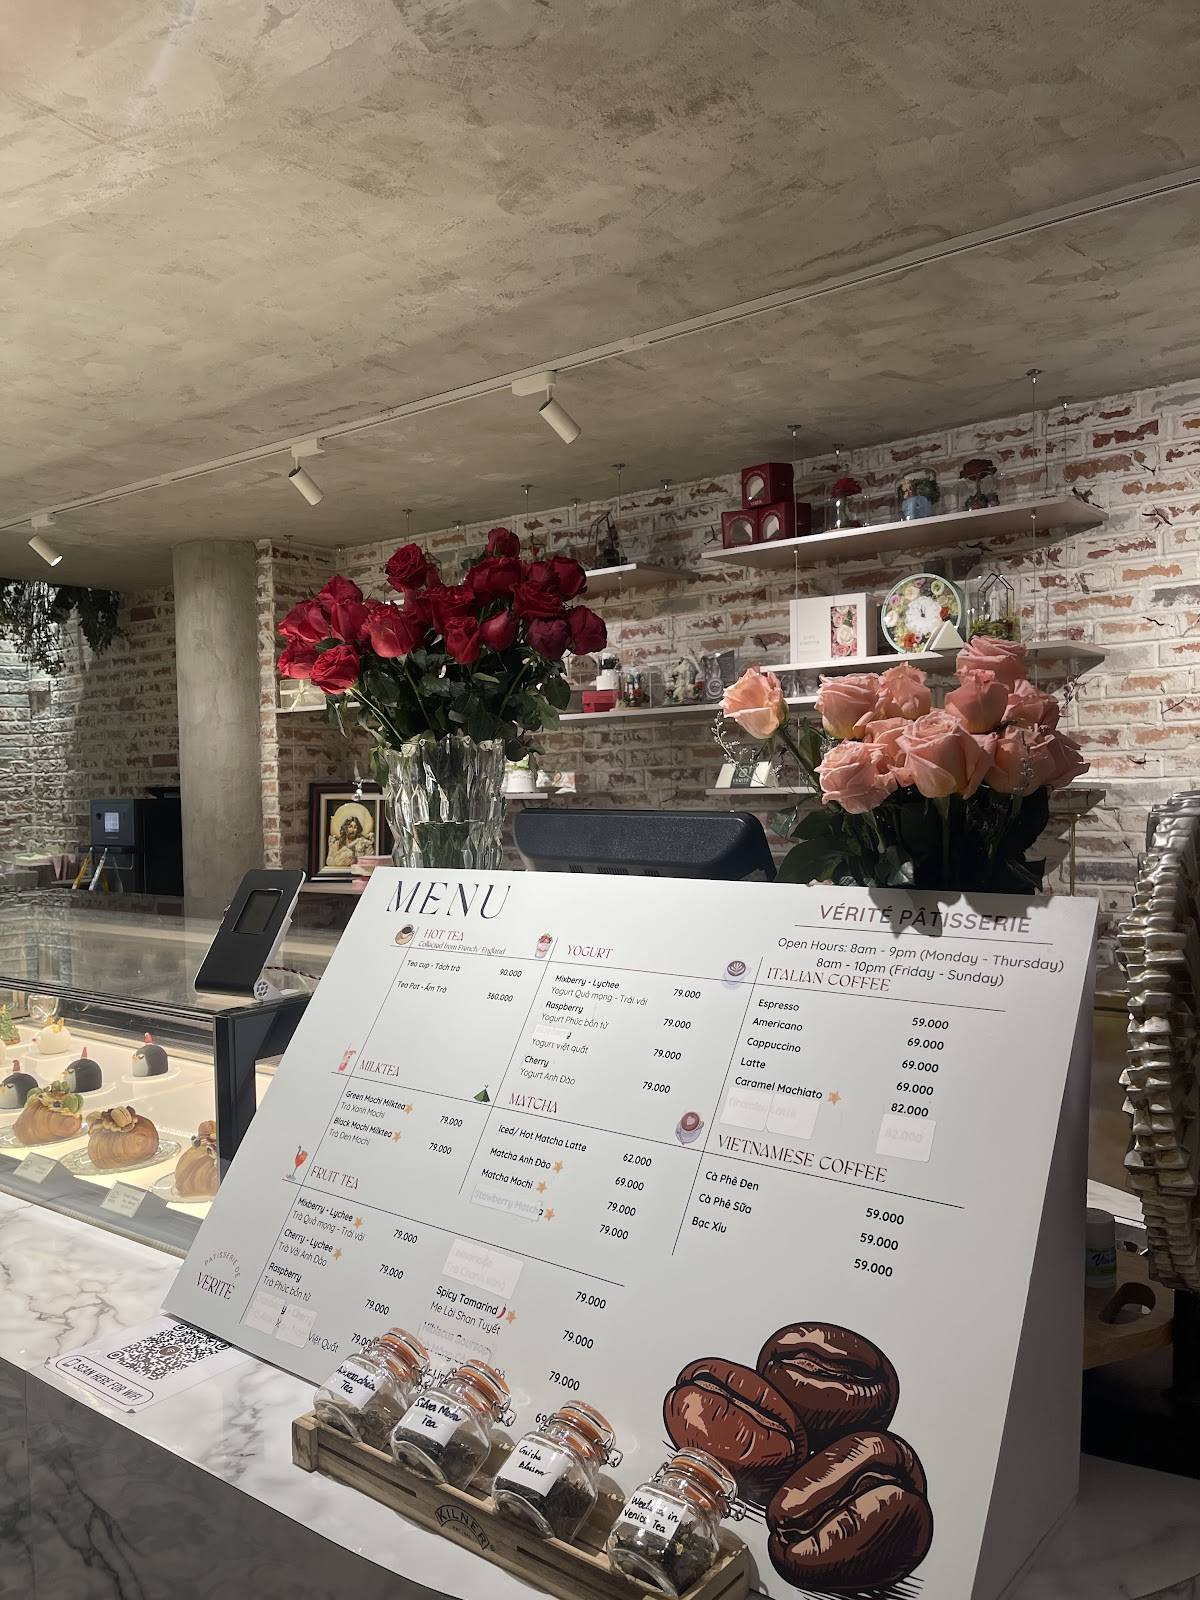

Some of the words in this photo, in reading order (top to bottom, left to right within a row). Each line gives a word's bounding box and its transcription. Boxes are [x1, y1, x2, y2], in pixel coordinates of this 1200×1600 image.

[386, 880, 512, 919] MENU
[820, 904, 893, 924] VÉRITÉ
[898, 907, 1032, 933] PÂTISSERIE
[424, 929, 445, 939] HOT
[447, 931, 464, 941] TEA
[567, 944, 613, 960] YOGURT
[778, 937, 808, 950] Open
[810, 940, 848, 953] Hours:
[850, 944, 877, 955] 8am
[889, 946, 916, 959] 9pm
[919, 949, 978, 966] (Monday
[992, 954, 1065, 973] Thursday)
[407, 960, 418, 968] Tea
[499, 969, 522, 978] 90.000
[767, 967, 824, 985] ITALIAN
[827, 973, 891, 992] COFFEE
[816, 958, 842, 969] 8am
[853, 961, 886, 975] 10pm
[889, 964, 935, 981] (Friday
[947, 969, 1004, 987] Sunday)
[397, 981, 409, 989] Tea
[409, 982, 419, 990] Pot
[555, 975, 587, 986] Mixberry
[592, 979, 620, 989] Lychee
[487, 992, 513, 1002] 360.000
[551, 987, 574, 997] Yogurt
[673, 988, 701, 999] 79.000
[545, 1001, 583, 1014] Raspberry
[758, 998, 800, 1011] Espresso
[541, 1013, 564, 1025] Yogurt
[663, 1018, 691, 1030] 79.000
[752, 1017, 803, 1032] Americano
[911, 1017, 949, 1030] 59.000
[532, 1038, 555, 1049] Yogurt
[747, 1037, 801, 1053] Cappuccino
[907, 1037, 944, 1050] 69.000
[524, 1055, 549, 1067] Cherry
[653, 1049, 682, 1060] 79.000
[360, 1059, 400, 1077] MILKTEA
[740, 1057, 766, 1069] Latte
[901, 1059, 939, 1073] 69.000
[520, 1068, 543, 1080] Yogurt
[544, 1071, 558, 1082] Anh
[642, 1082, 670, 1094] 79.000
[735, 1076, 775, 1091] Caramel
[776, 1084, 823, 1099] Machiato
[896, 1082, 934, 1096] 69.000
[345, 1091, 364, 1101] Green
[365, 1094, 382, 1105] Mochi
[383, 1099, 406, 1110] Milktea
[509, 1092, 558, 1114] MATCHA
[351, 1104, 367, 1115] Xanh
[368, 1108, 386, 1119] Mochi
[891, 1103, 929, 1117] 82.000
[333, 1116, 351, 1128] Black
[351, 1121, 369, 1132] Mochi
[370, 1126, 392, 1138] Milktea
[440, 1115, 463, 1127] 79.000
[352, 1135, 371, 1146] Mochi
[498, 1124, 519, 1136] Iced/
[519, 1129, 534, 1140] Hot
[535, 1133, 564, 1147] Matcha
[565, 1140, 587, 1152] Latte
[428, 1142, 452, 1155] 79.000
[490, 1147, 517, 1161] Matcha
[518, 1154, 534, 1165] Anh
[622, 1153, 652, 1167] 62.000
[718, 1134, 815, 1168] VIETNAMESE
[819, 1156, 888, 1183] COFFEE
[311, 1165, 339, 1182] FRUIT
[341, 1174, 359, 1189] TEA
[481, 1168, 509, 1183] Matcha
[510, 1175, 533, 1189] Mochi
[615, 1176, 644, 1191] 69.000
[705, 1171, 719, 1182] Cà
[719, 1173, 739, 1186] Phê
[739, 1179, 759, 1191] Đen
[297, 1198, 325, 1215] Mixberry
[330, 1207, 354, 1222] Lychee
[607, 1201, 636, 1217] 79.000
[698, 1193, 712, 1204] Cà
[713, 1196, 731, 1209] Phê
[732, 1201, 752, 1214] Sữa
[691, 1216, 710, 1229] Bạc
[865, 1207, 904, 1225] 59.000
[393, 1229, 418, 1244] 79.000
[599, 1224, 629, 1240] 79.000
[284, 1228, 305, 1244] Cherry
[310, 1237, 334, 1253] Lychee
[860, 1232, 899, 1251] 59.000
[300, 1250, 313, 1262] Anh
[268, 1262, 302, 1283] Raspberry
[379, 1263, 404, 1280] 79.000
[854, 1258, 893, 1277] 59.000
[364, 1299, 389, 1316] 79.000
[436, 1285, 457, 1302] Spicy
[459, 1293, 498, 1315] Tamarind
[575, 1291, 606, 1309] 79.000
[430, 1302, 442, 1313] Me
[455, 1310, 476, 1326] Shan
[562, 1330, 593, 1349] 79.000
[73, 1363, 97, 1376] SCAN
[91, 1374, 114, 1385] HERE
[107, 1382, 127, 1393] FOR
[548, 1371, 580, 1391] 79.000
[340, 1379, 353, 1394] Tea
[422, 1415, 438, 1428] Tea
[667, 1511, 679, 1523] in
[436, 1507, 487, 1546] KILNER
[652, 1519, 666, 1533] Tea
